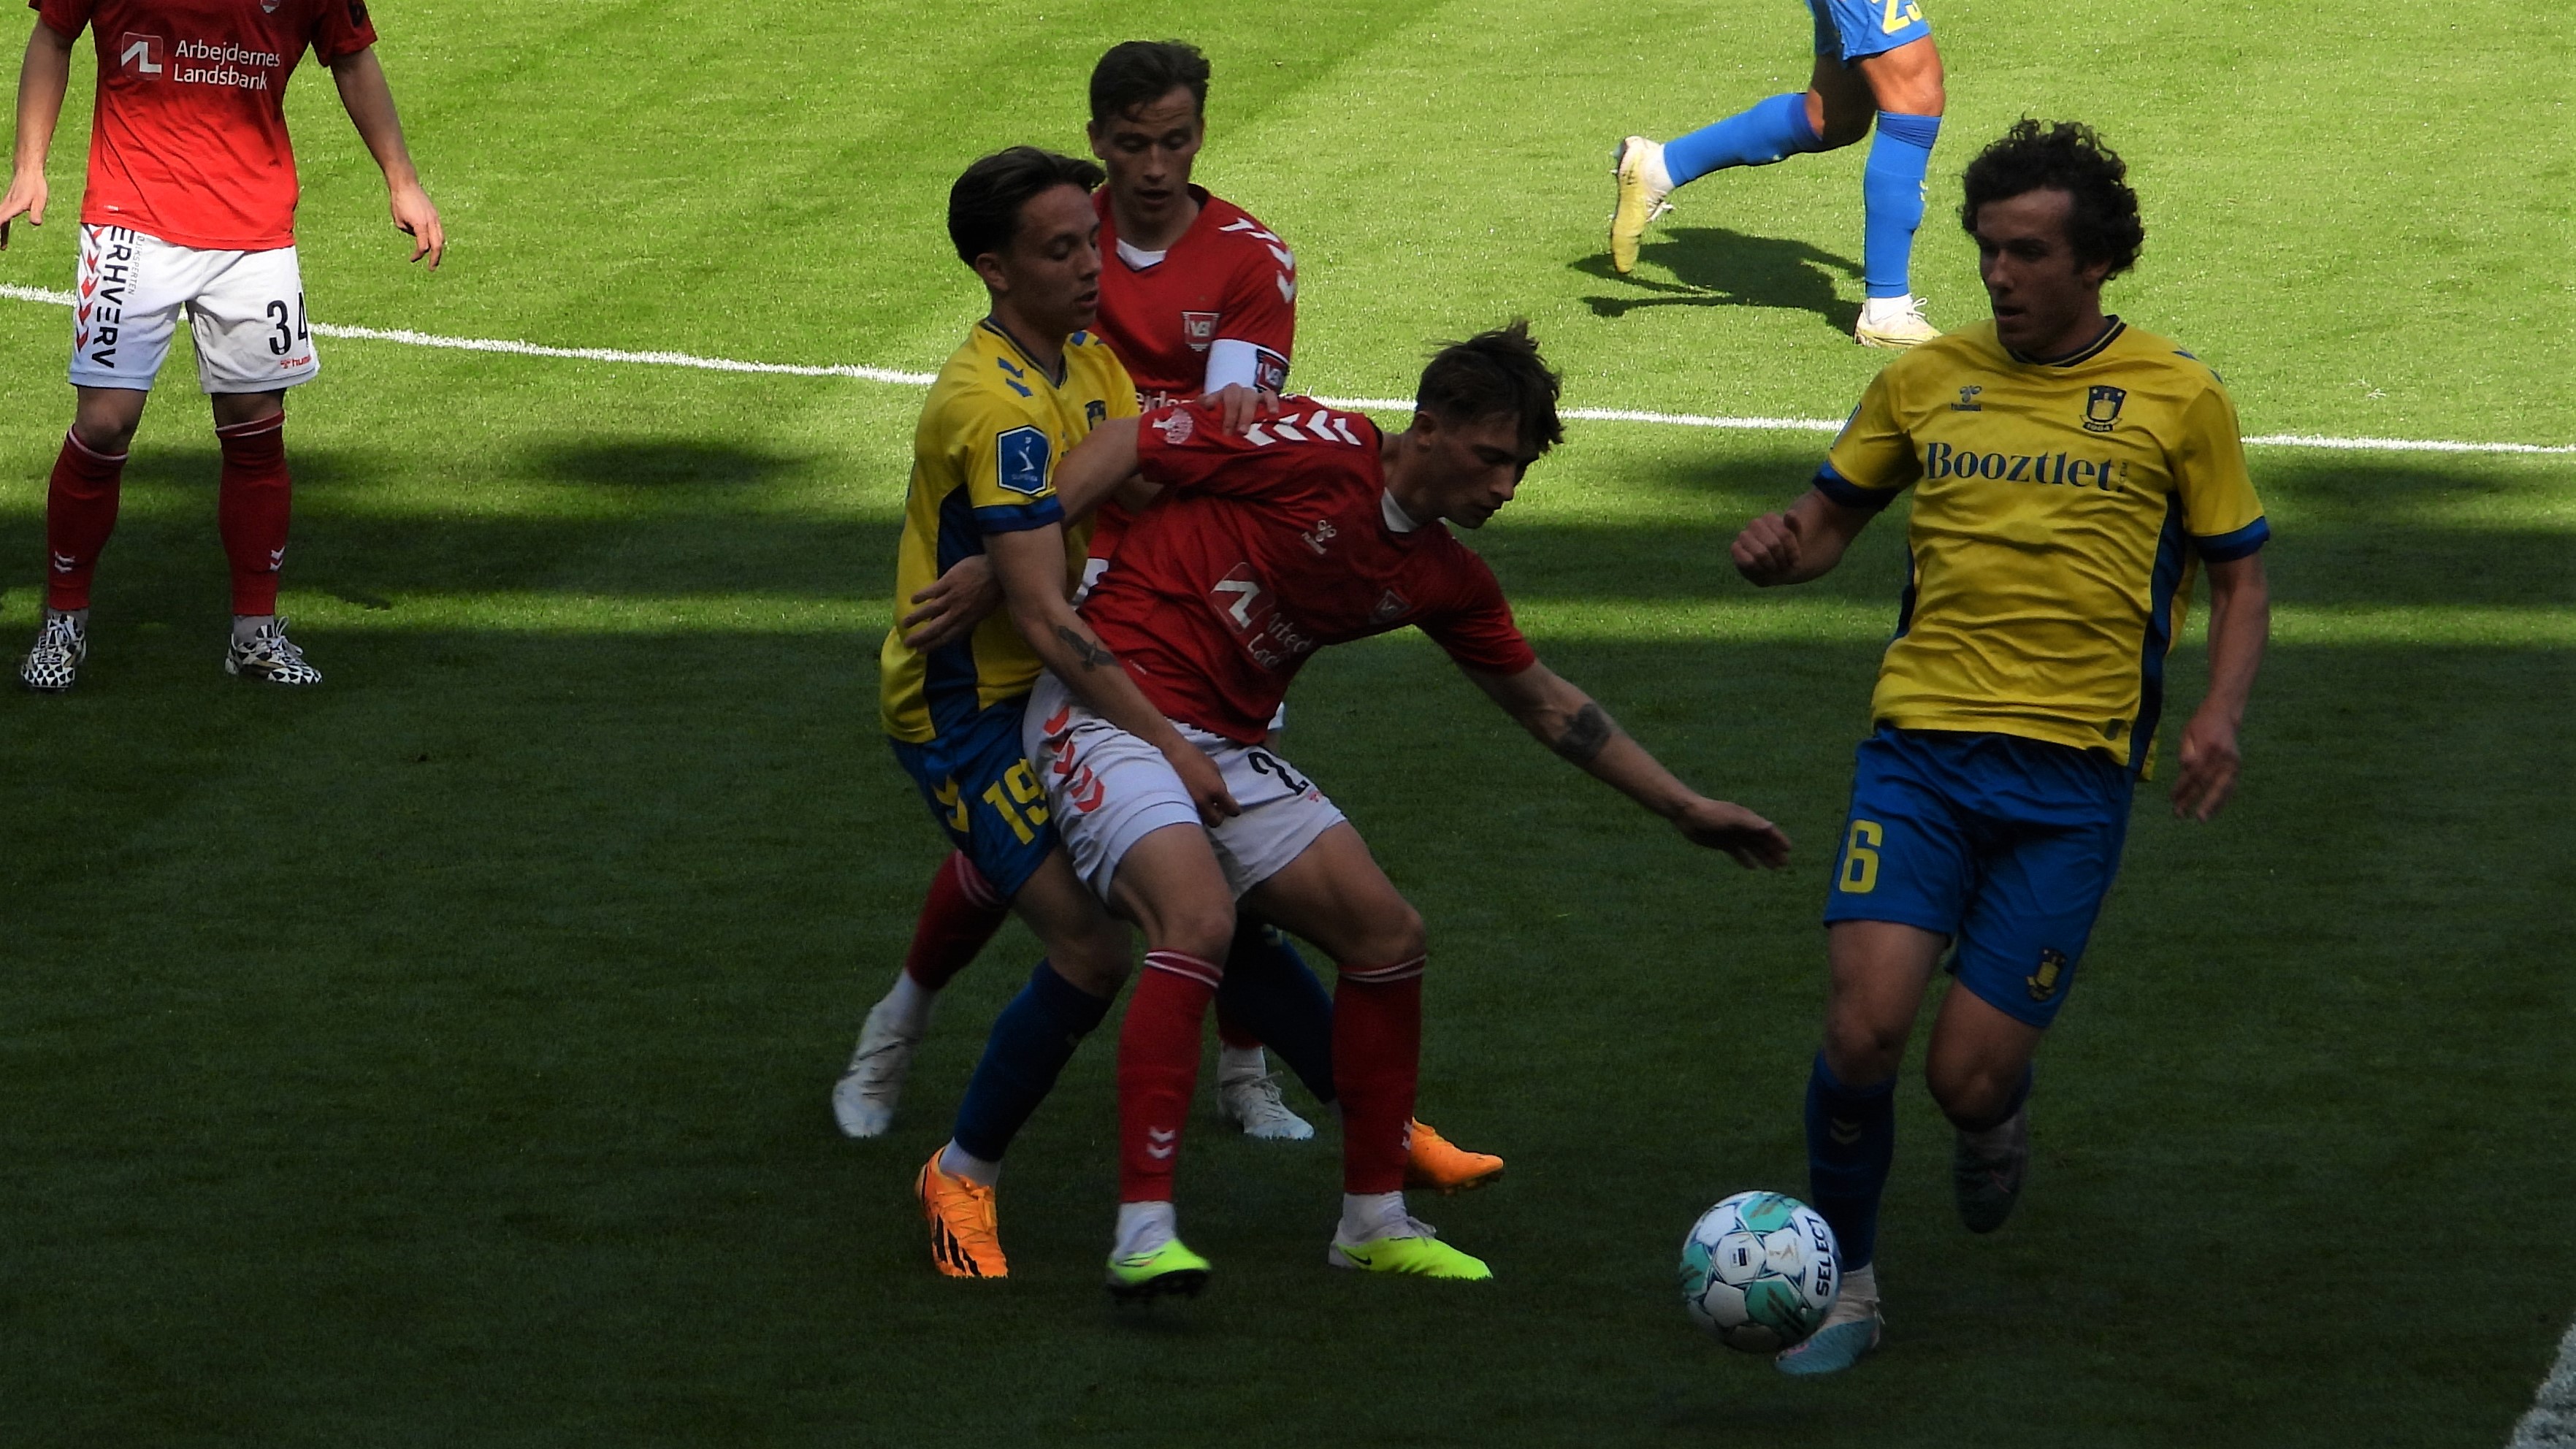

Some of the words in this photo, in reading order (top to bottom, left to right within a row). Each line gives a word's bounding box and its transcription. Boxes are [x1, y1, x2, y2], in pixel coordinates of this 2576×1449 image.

[174, 64, 267, 90] Landsbank
[175, 39, 280, 67] Arbejdernes
[91, 226, 135, 369] ERHVERV
[267, 291, 309, 356] 34
[1928, 443, 2113, 491] Booztlet
[982, 757, 1050, 845] 19
[1839, 819, 1883, 893] 6
[1804, 1215, 1832, 1297] SELECT
